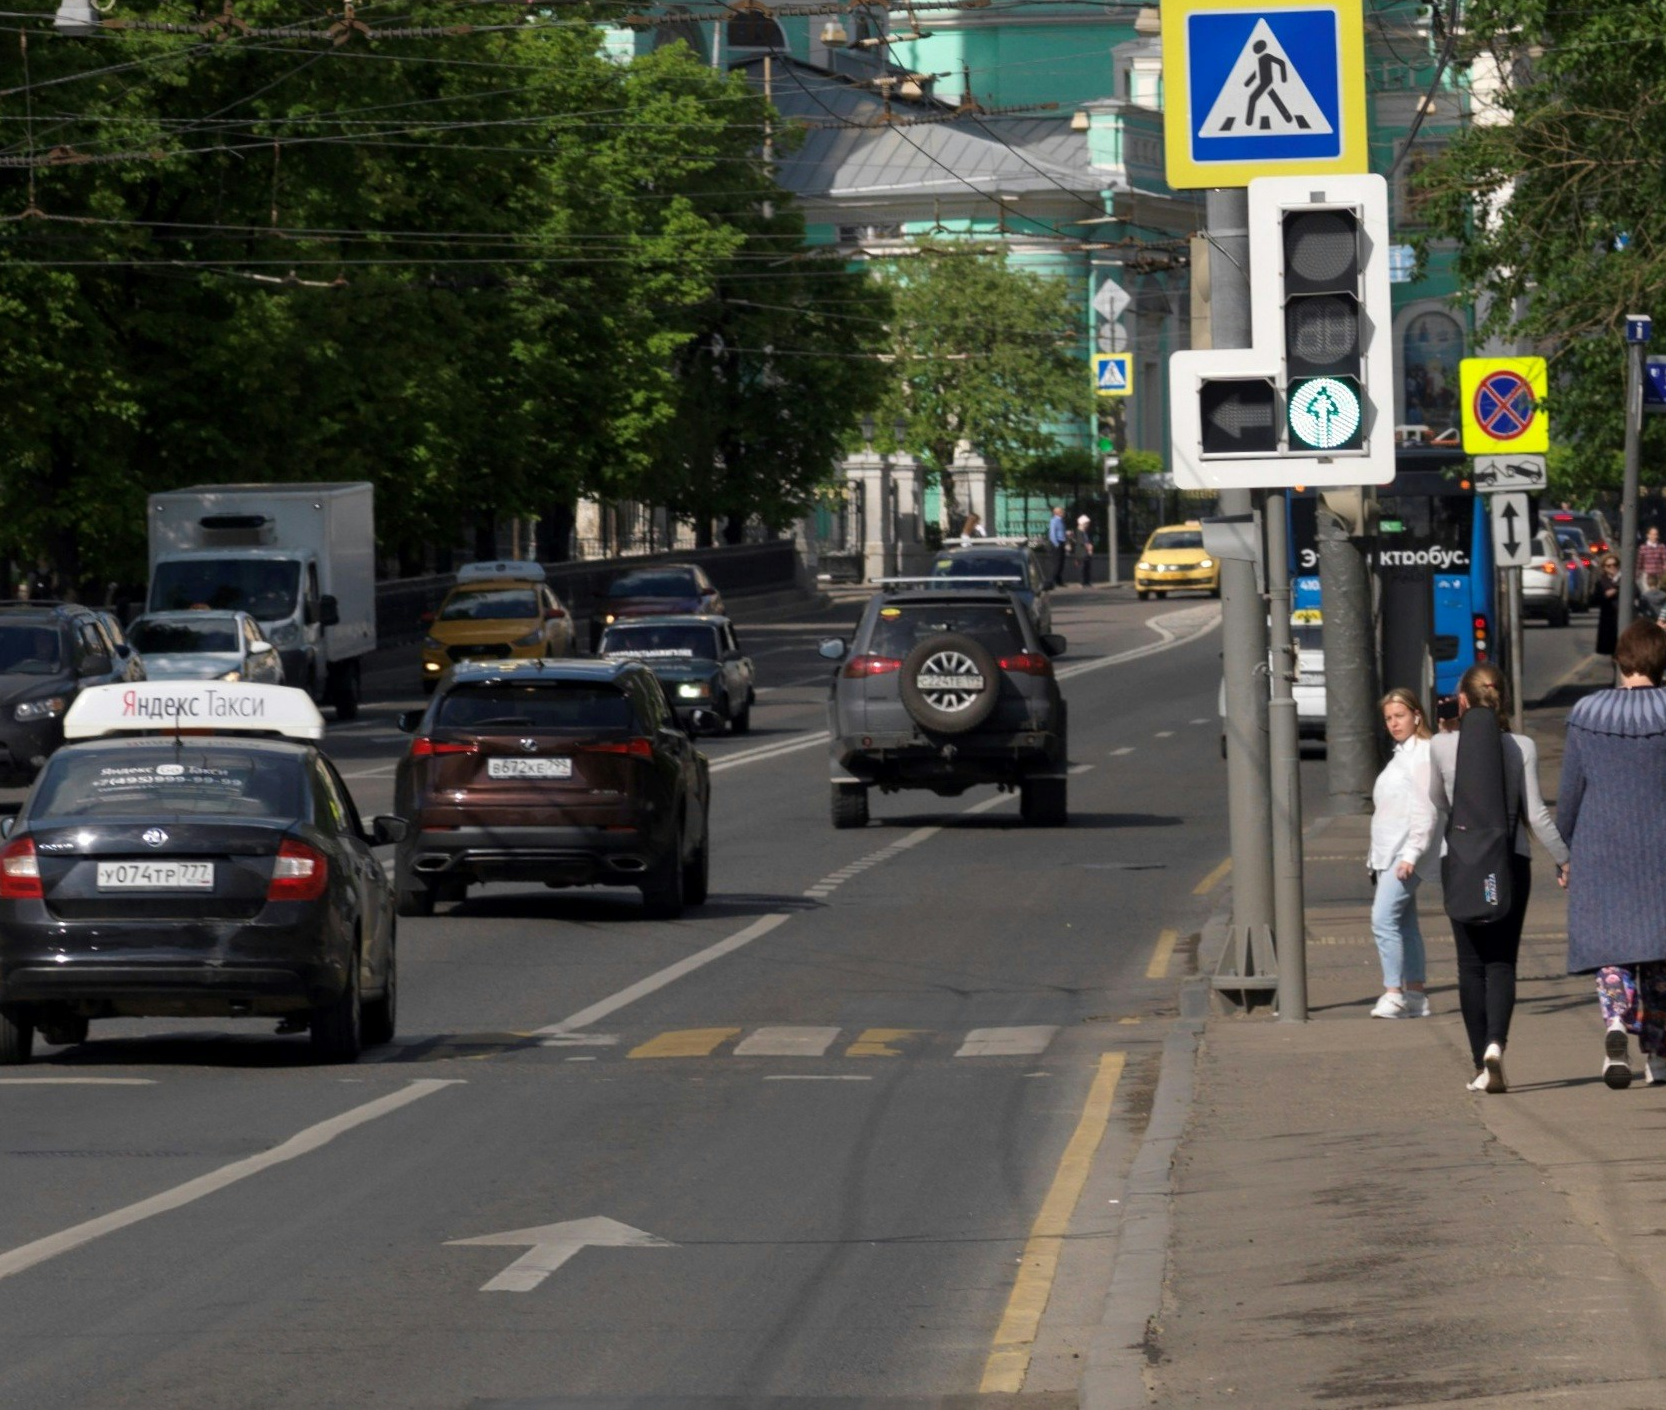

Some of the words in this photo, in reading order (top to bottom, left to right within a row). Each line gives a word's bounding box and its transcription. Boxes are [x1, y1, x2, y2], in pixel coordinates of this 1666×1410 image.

[123, 689, 199, 719] Яндекс
[205, 689, 264, 717] Такси
[100, 766, 154, 776] Яндекс
[188, 765, 228, 777] Такси
[104, 865, 175, 884] У074ТР
